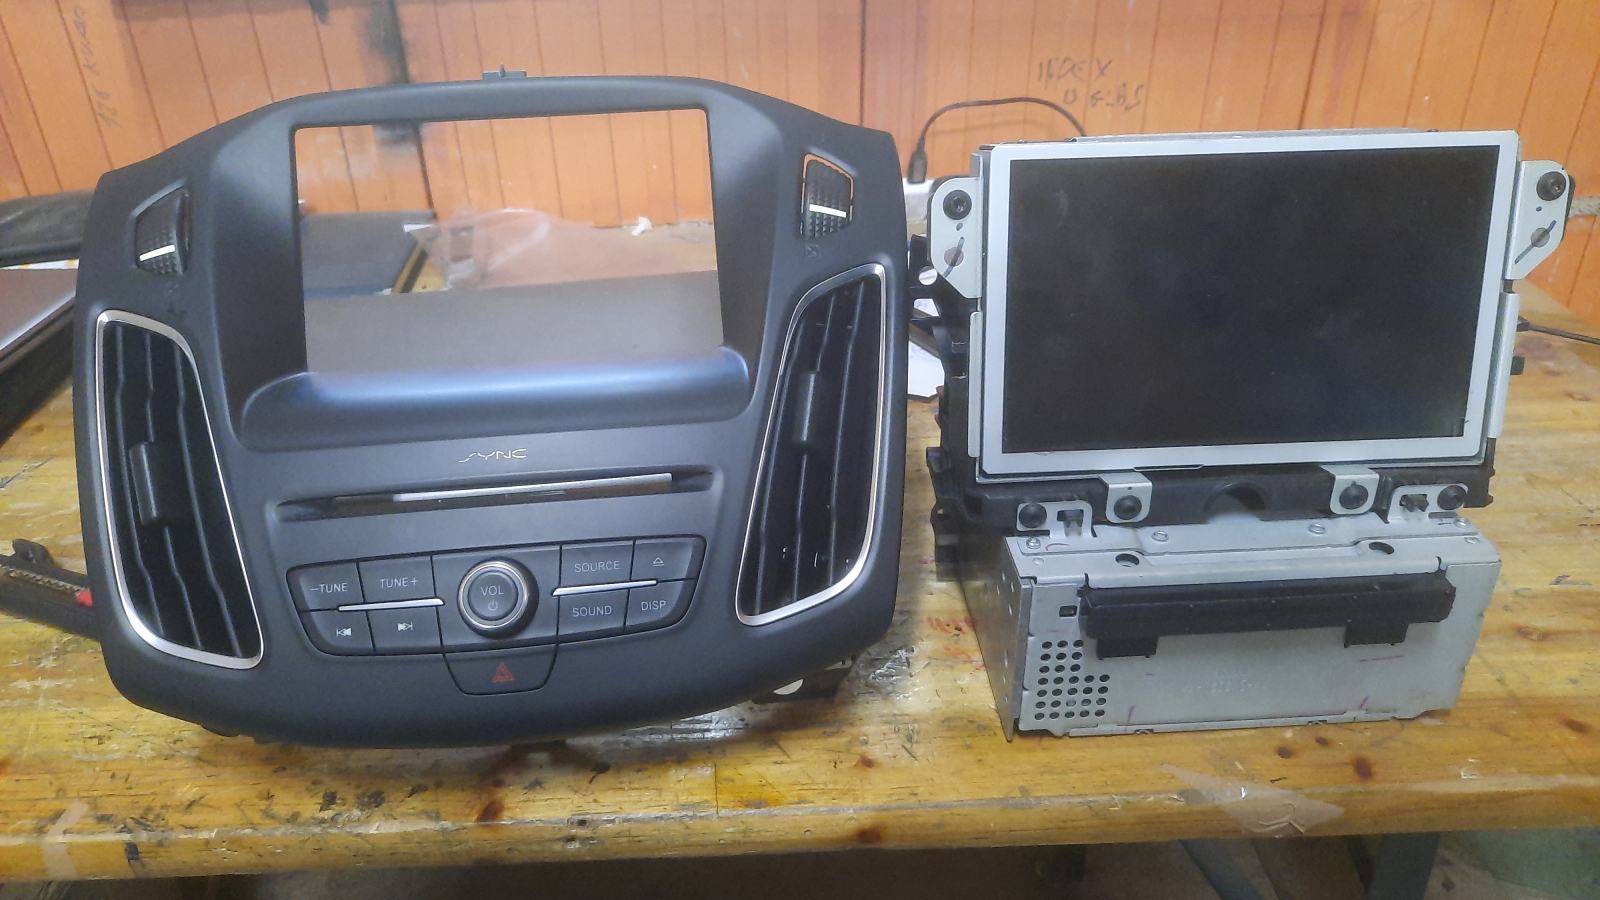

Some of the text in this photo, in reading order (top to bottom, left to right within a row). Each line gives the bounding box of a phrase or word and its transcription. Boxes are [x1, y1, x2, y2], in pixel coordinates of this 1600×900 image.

[458, 447, 528, 463] SYNC
[574, 560, 620, 573] SOURCE
[379, 577, 419, 589] TUNE+
[480, 585, 505, 597] VOL
[572, 605, 613, 617] SOUND
[641, 600, 667, 611] DISP
